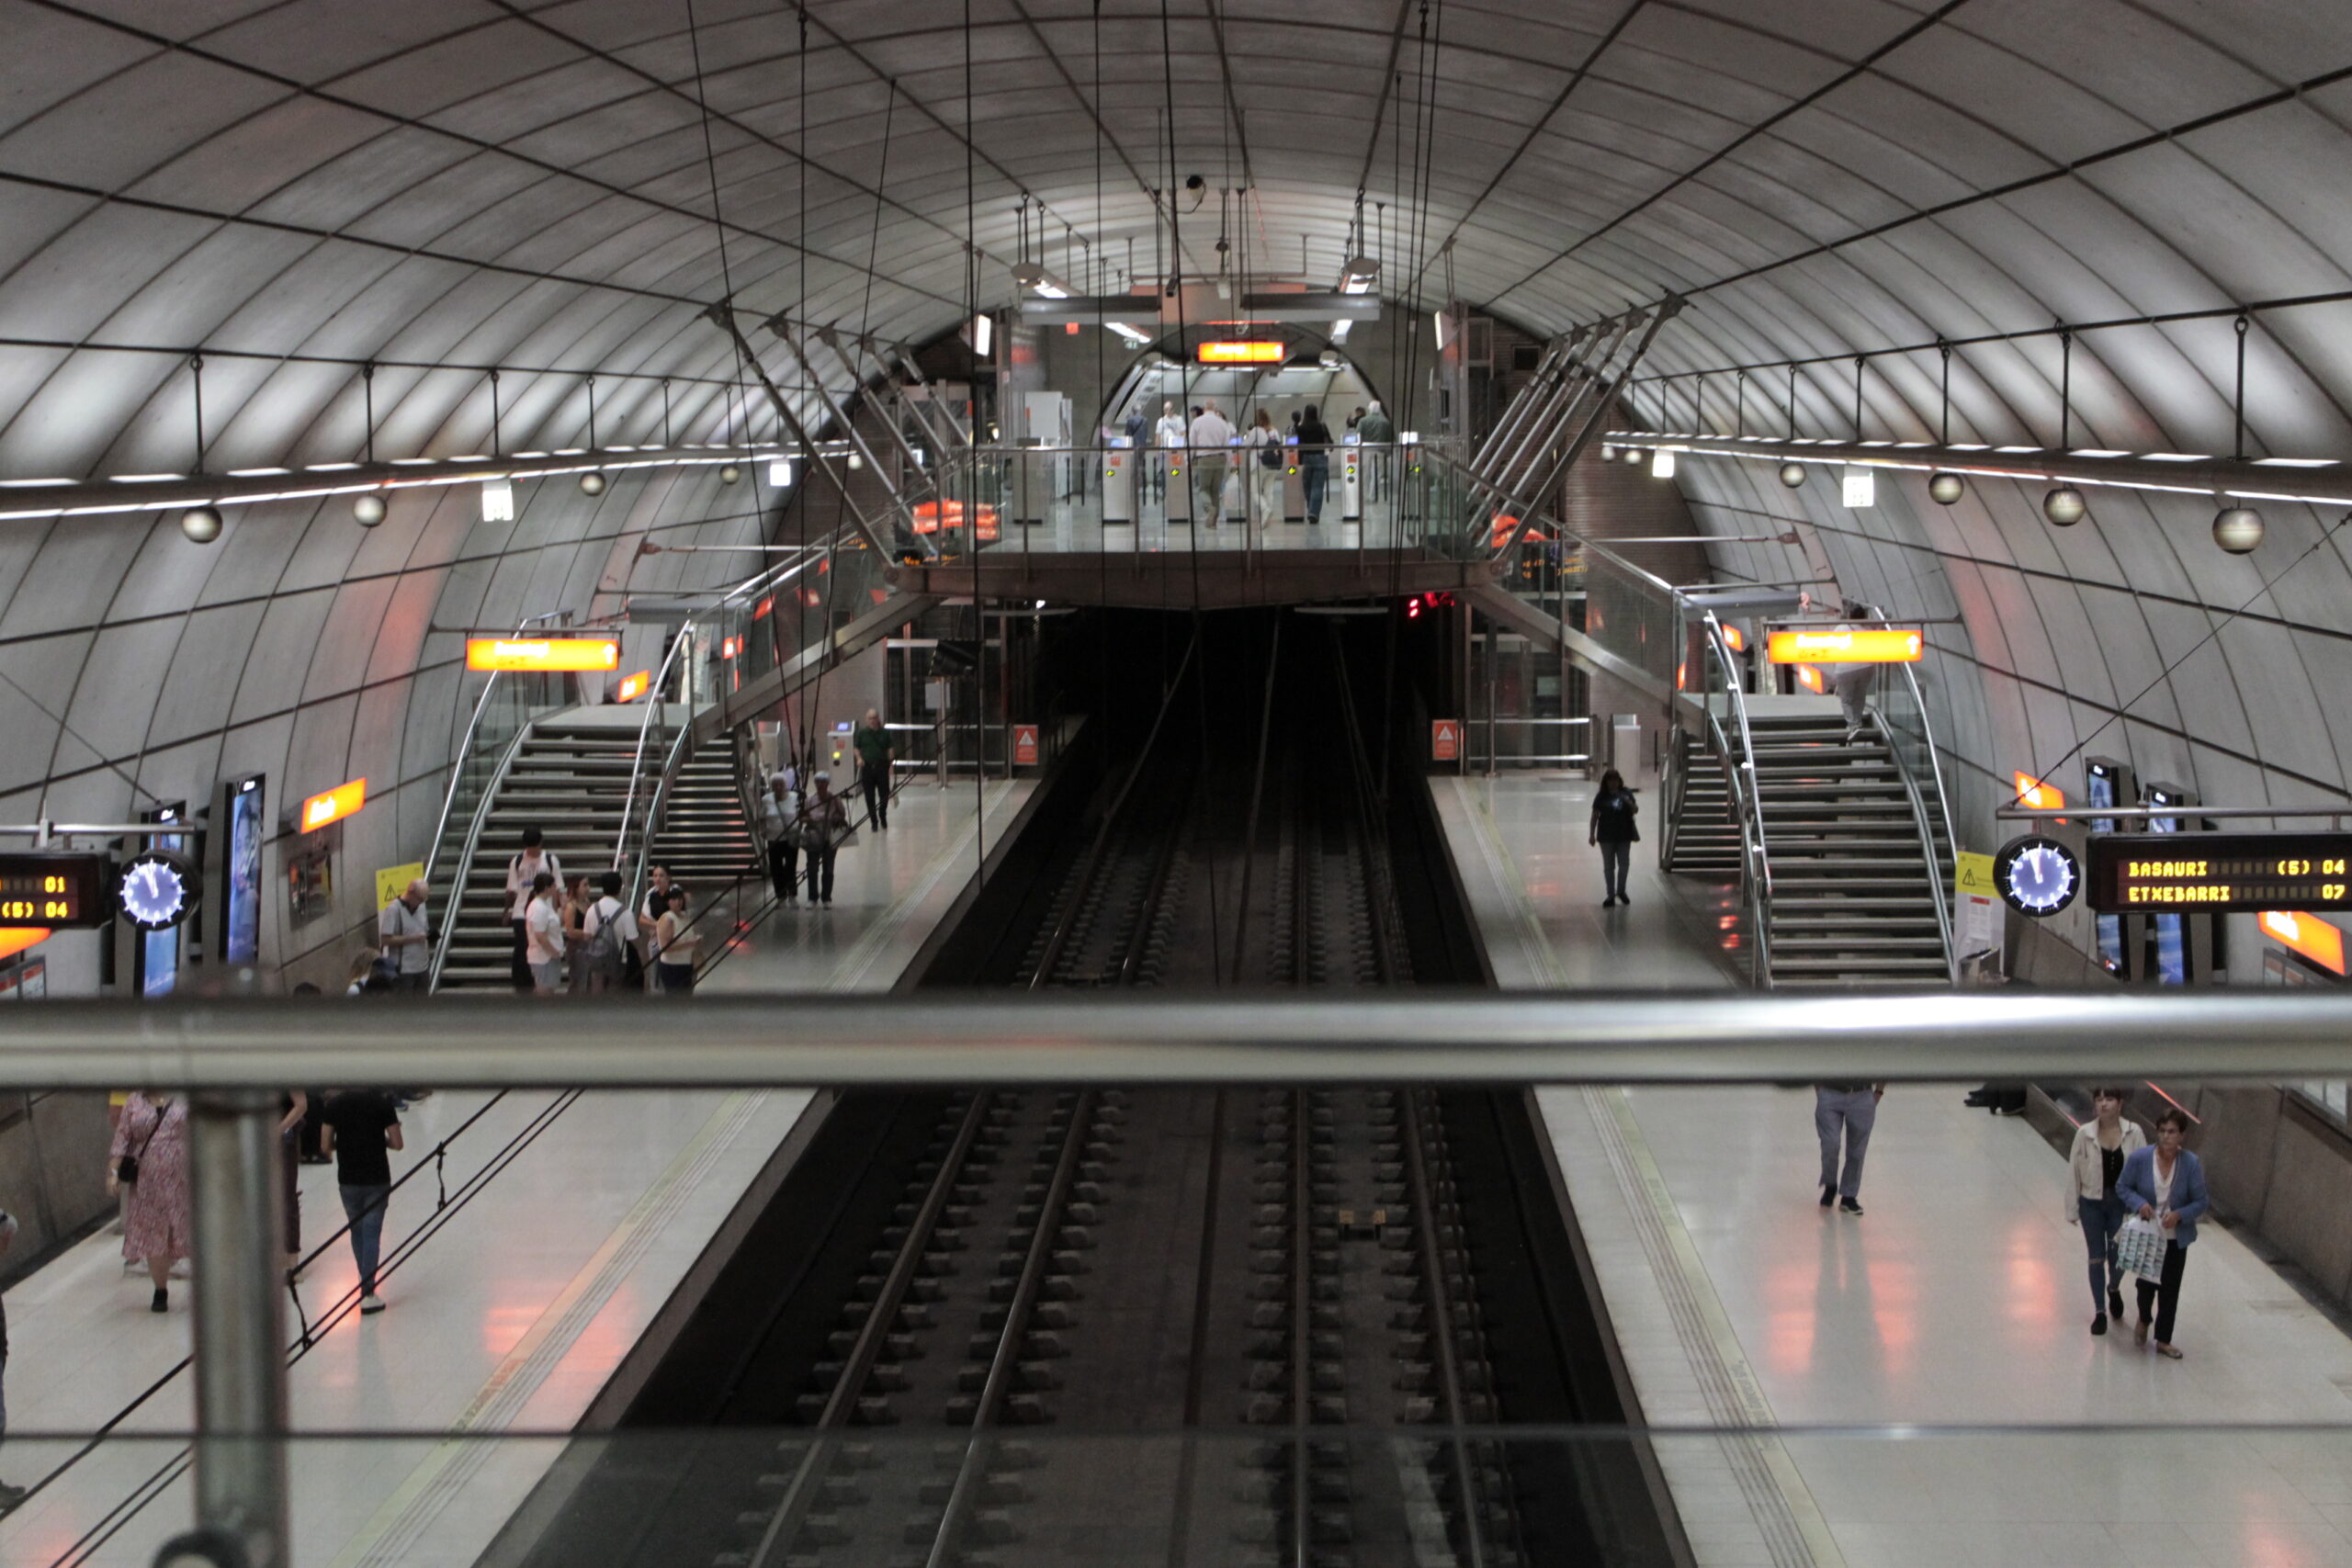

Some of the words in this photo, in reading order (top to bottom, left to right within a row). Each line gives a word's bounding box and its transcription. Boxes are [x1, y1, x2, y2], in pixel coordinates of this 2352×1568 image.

[2129, 861, 2208, 877] BASAURI
[2322, 859, 2346, 875] 04
[44, 875, 65, 893] 01
[2129, 886, 2231, 902] ETXEBARRI
[2322, 884, 2346, 900] 07
[45, 901, 68, 919] 04
